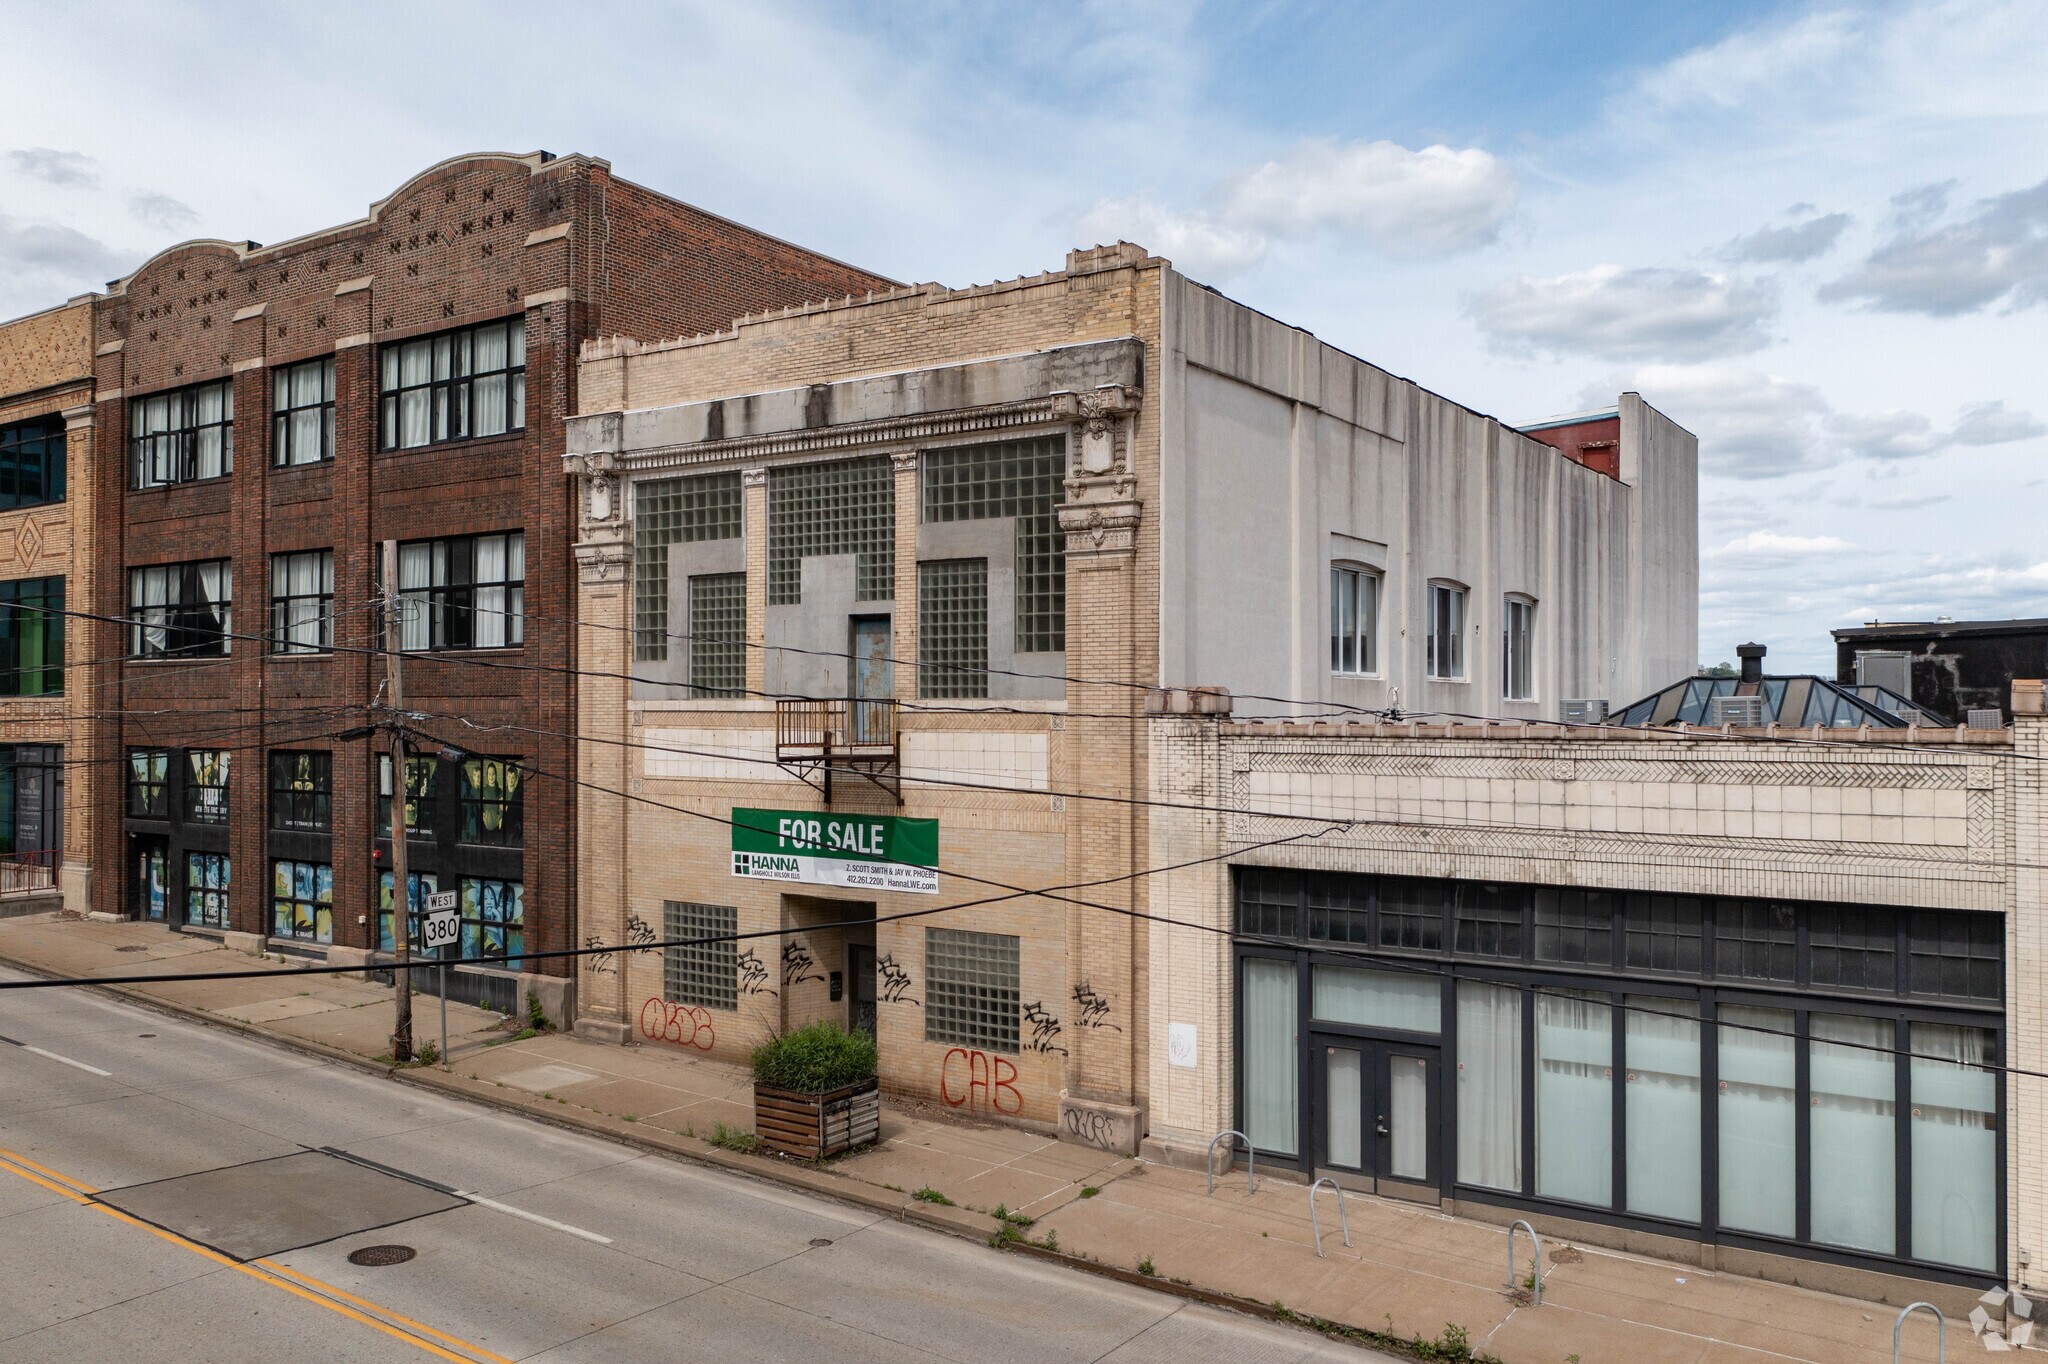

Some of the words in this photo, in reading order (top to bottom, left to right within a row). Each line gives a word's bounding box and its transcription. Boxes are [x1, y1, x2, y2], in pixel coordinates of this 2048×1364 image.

[779, 818, 822, 850] FOR
[827, 821, 884, 855] SALE
[752, 855, 800, 872] HANNA
[851, 864, 871, 873] SCOTT
[870, 866, 888, 875] SMITH
[894, 868, 904, 876] JAY
[913, 869, 936, 879] PHOEBE
[752, 869, 773, 877] LANGHOLZ
[846, 875, 884, 886] 412.261.2200
[887, 878, 937, 890] HannaLWE.com
[430, 894, 454, 908] WEST
[427, 918, 457, 941] 380
[941, 1048, 1025, 1116] CAB
